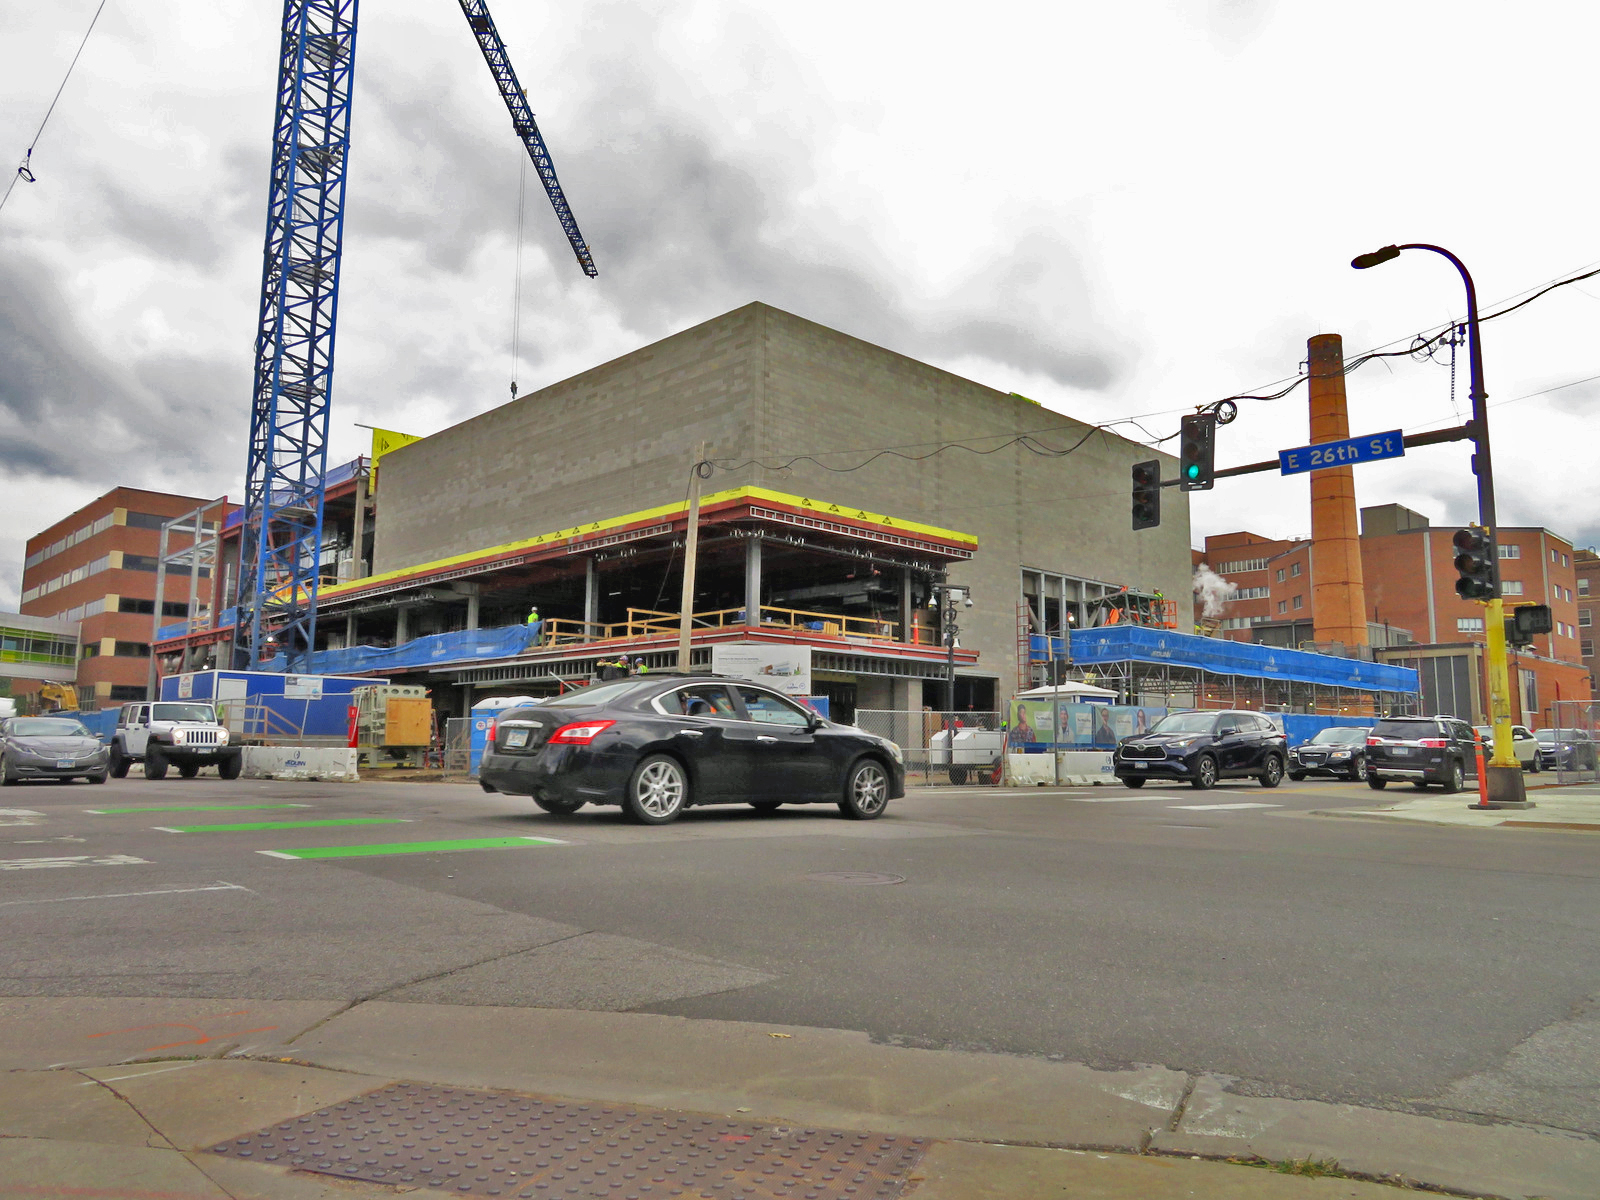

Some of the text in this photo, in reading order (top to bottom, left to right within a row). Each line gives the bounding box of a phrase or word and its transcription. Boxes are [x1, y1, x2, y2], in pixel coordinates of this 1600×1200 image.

[1287, 438, 1393, 469] E 26th St
